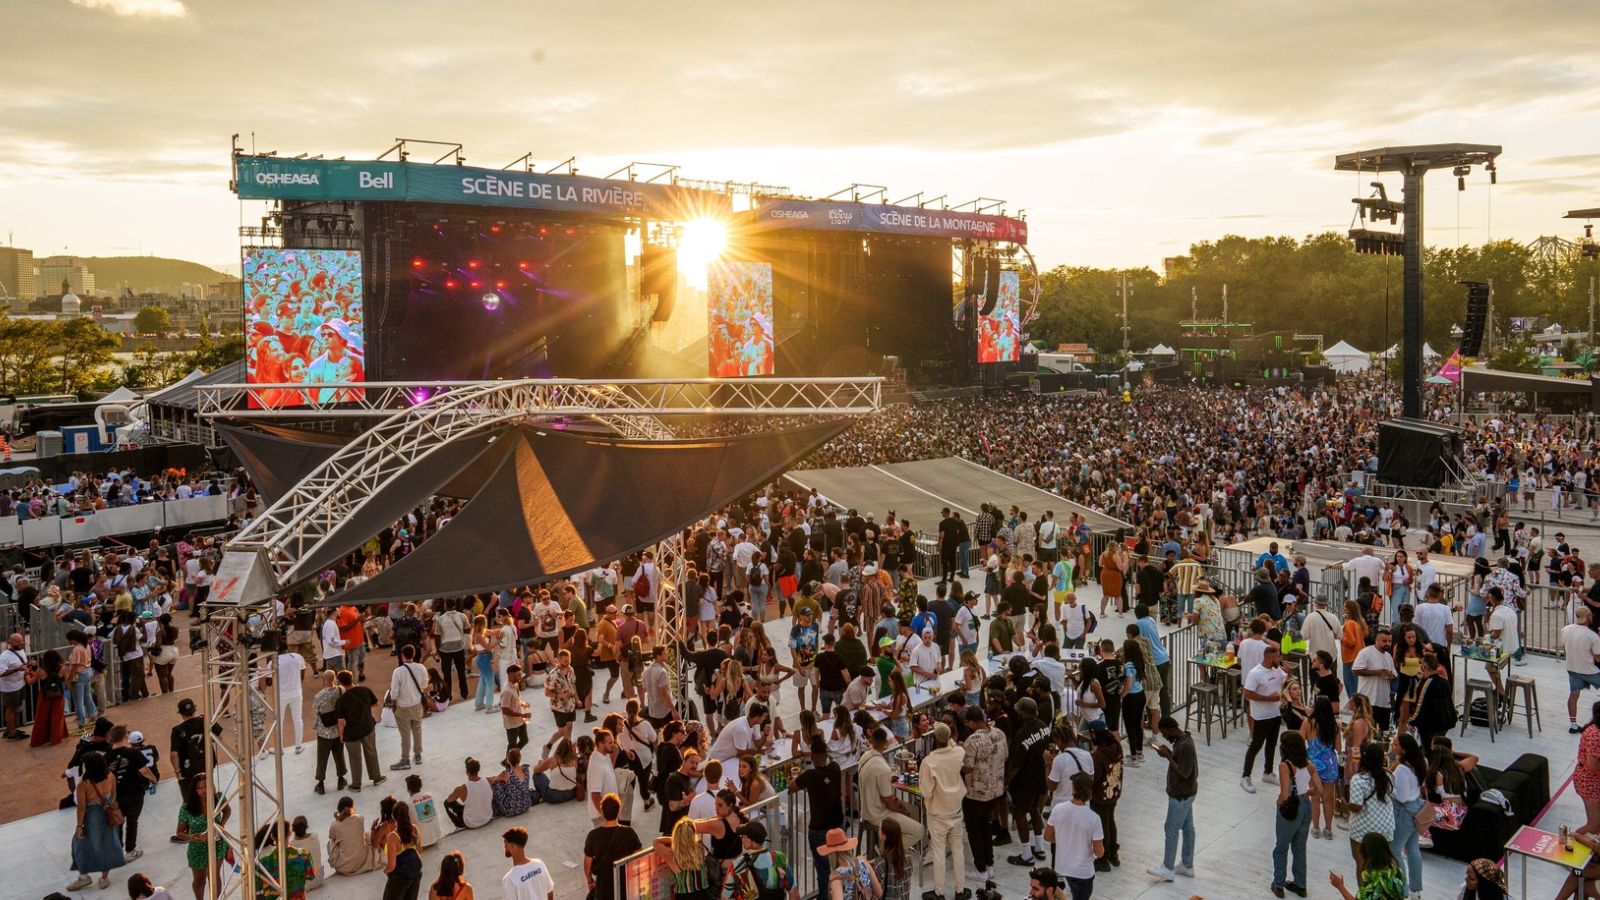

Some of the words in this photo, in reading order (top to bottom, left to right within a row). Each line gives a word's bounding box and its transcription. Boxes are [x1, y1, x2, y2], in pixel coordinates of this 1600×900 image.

[256, 173, 319, 185] OSHEAGA
[359, 171, 393, 189] Bell
[462, 175, 524, 197] SCÈNE
[528, 183, 552, 199] DE
[556, 185, 578, 202] LA
[582, 186, 643, 206] RIVIÈRE
[771, 210, 808, 219] OSHEAGA
[880, 211, 912, 226] SCÈNE
[914, 215, 927, 228] DE
[929, 216, 941, 229] LA
[943, 218, 996, 233] MONTAGNE
